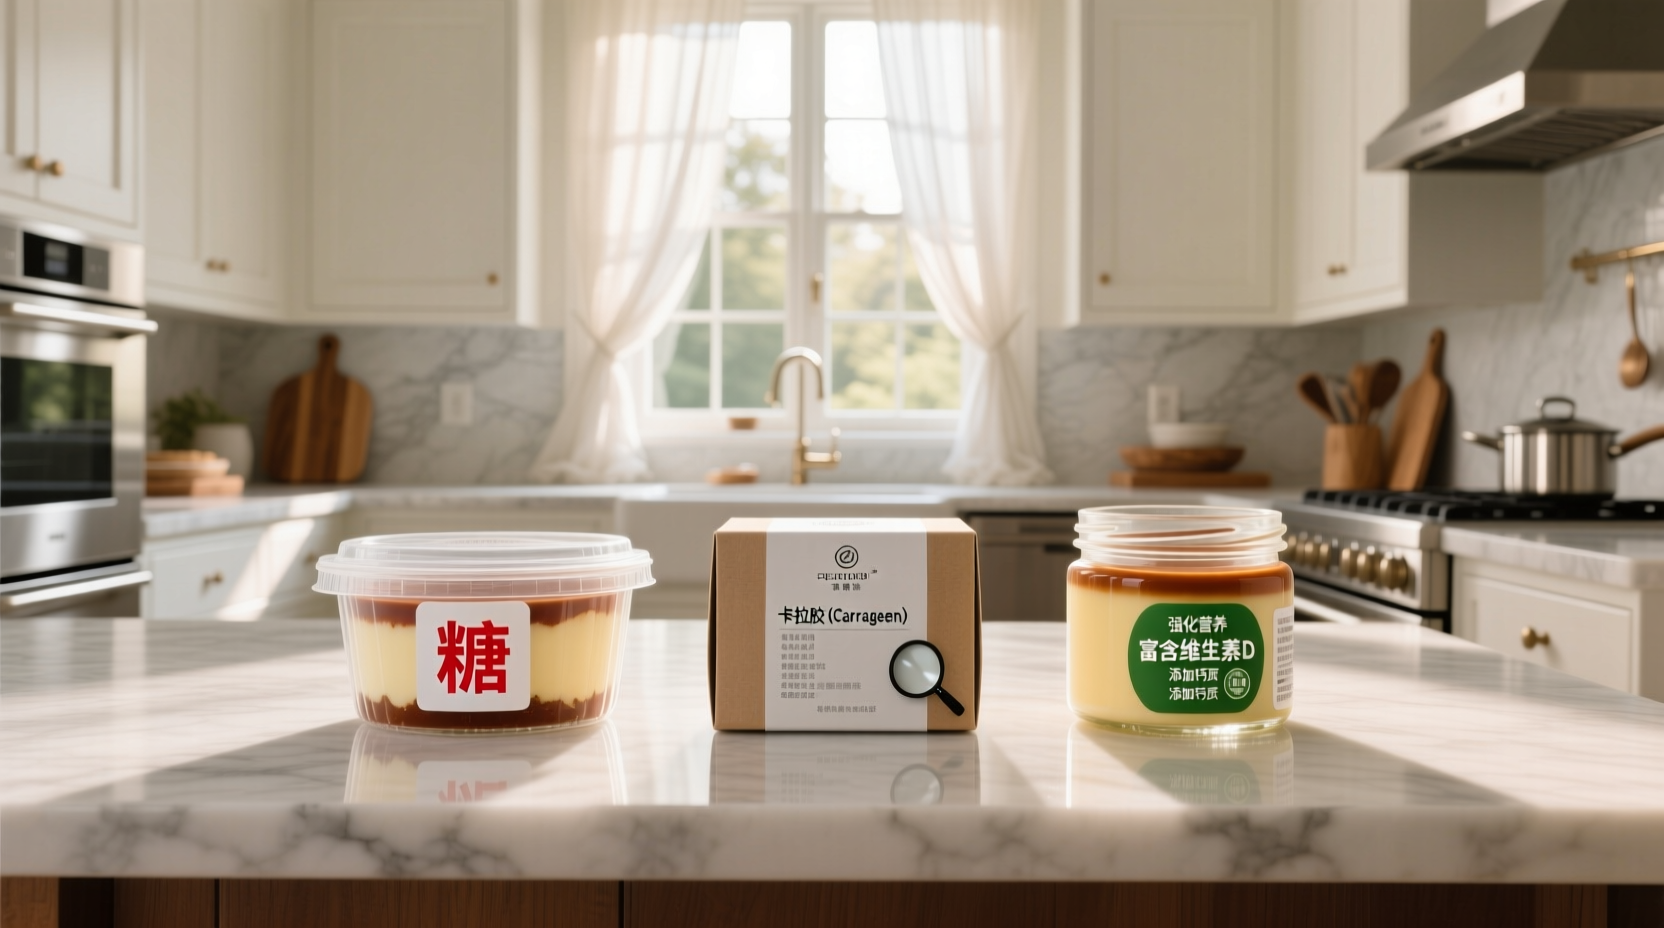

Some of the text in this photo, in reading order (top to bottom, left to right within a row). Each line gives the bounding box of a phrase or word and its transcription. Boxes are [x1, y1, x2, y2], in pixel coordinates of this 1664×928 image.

[778, 606, 908, 626] 卡拉胶 (Carrageen)
[437, 620, 510, 694] 糖
[1139, 638, 1255, 662] 富含维生素D
